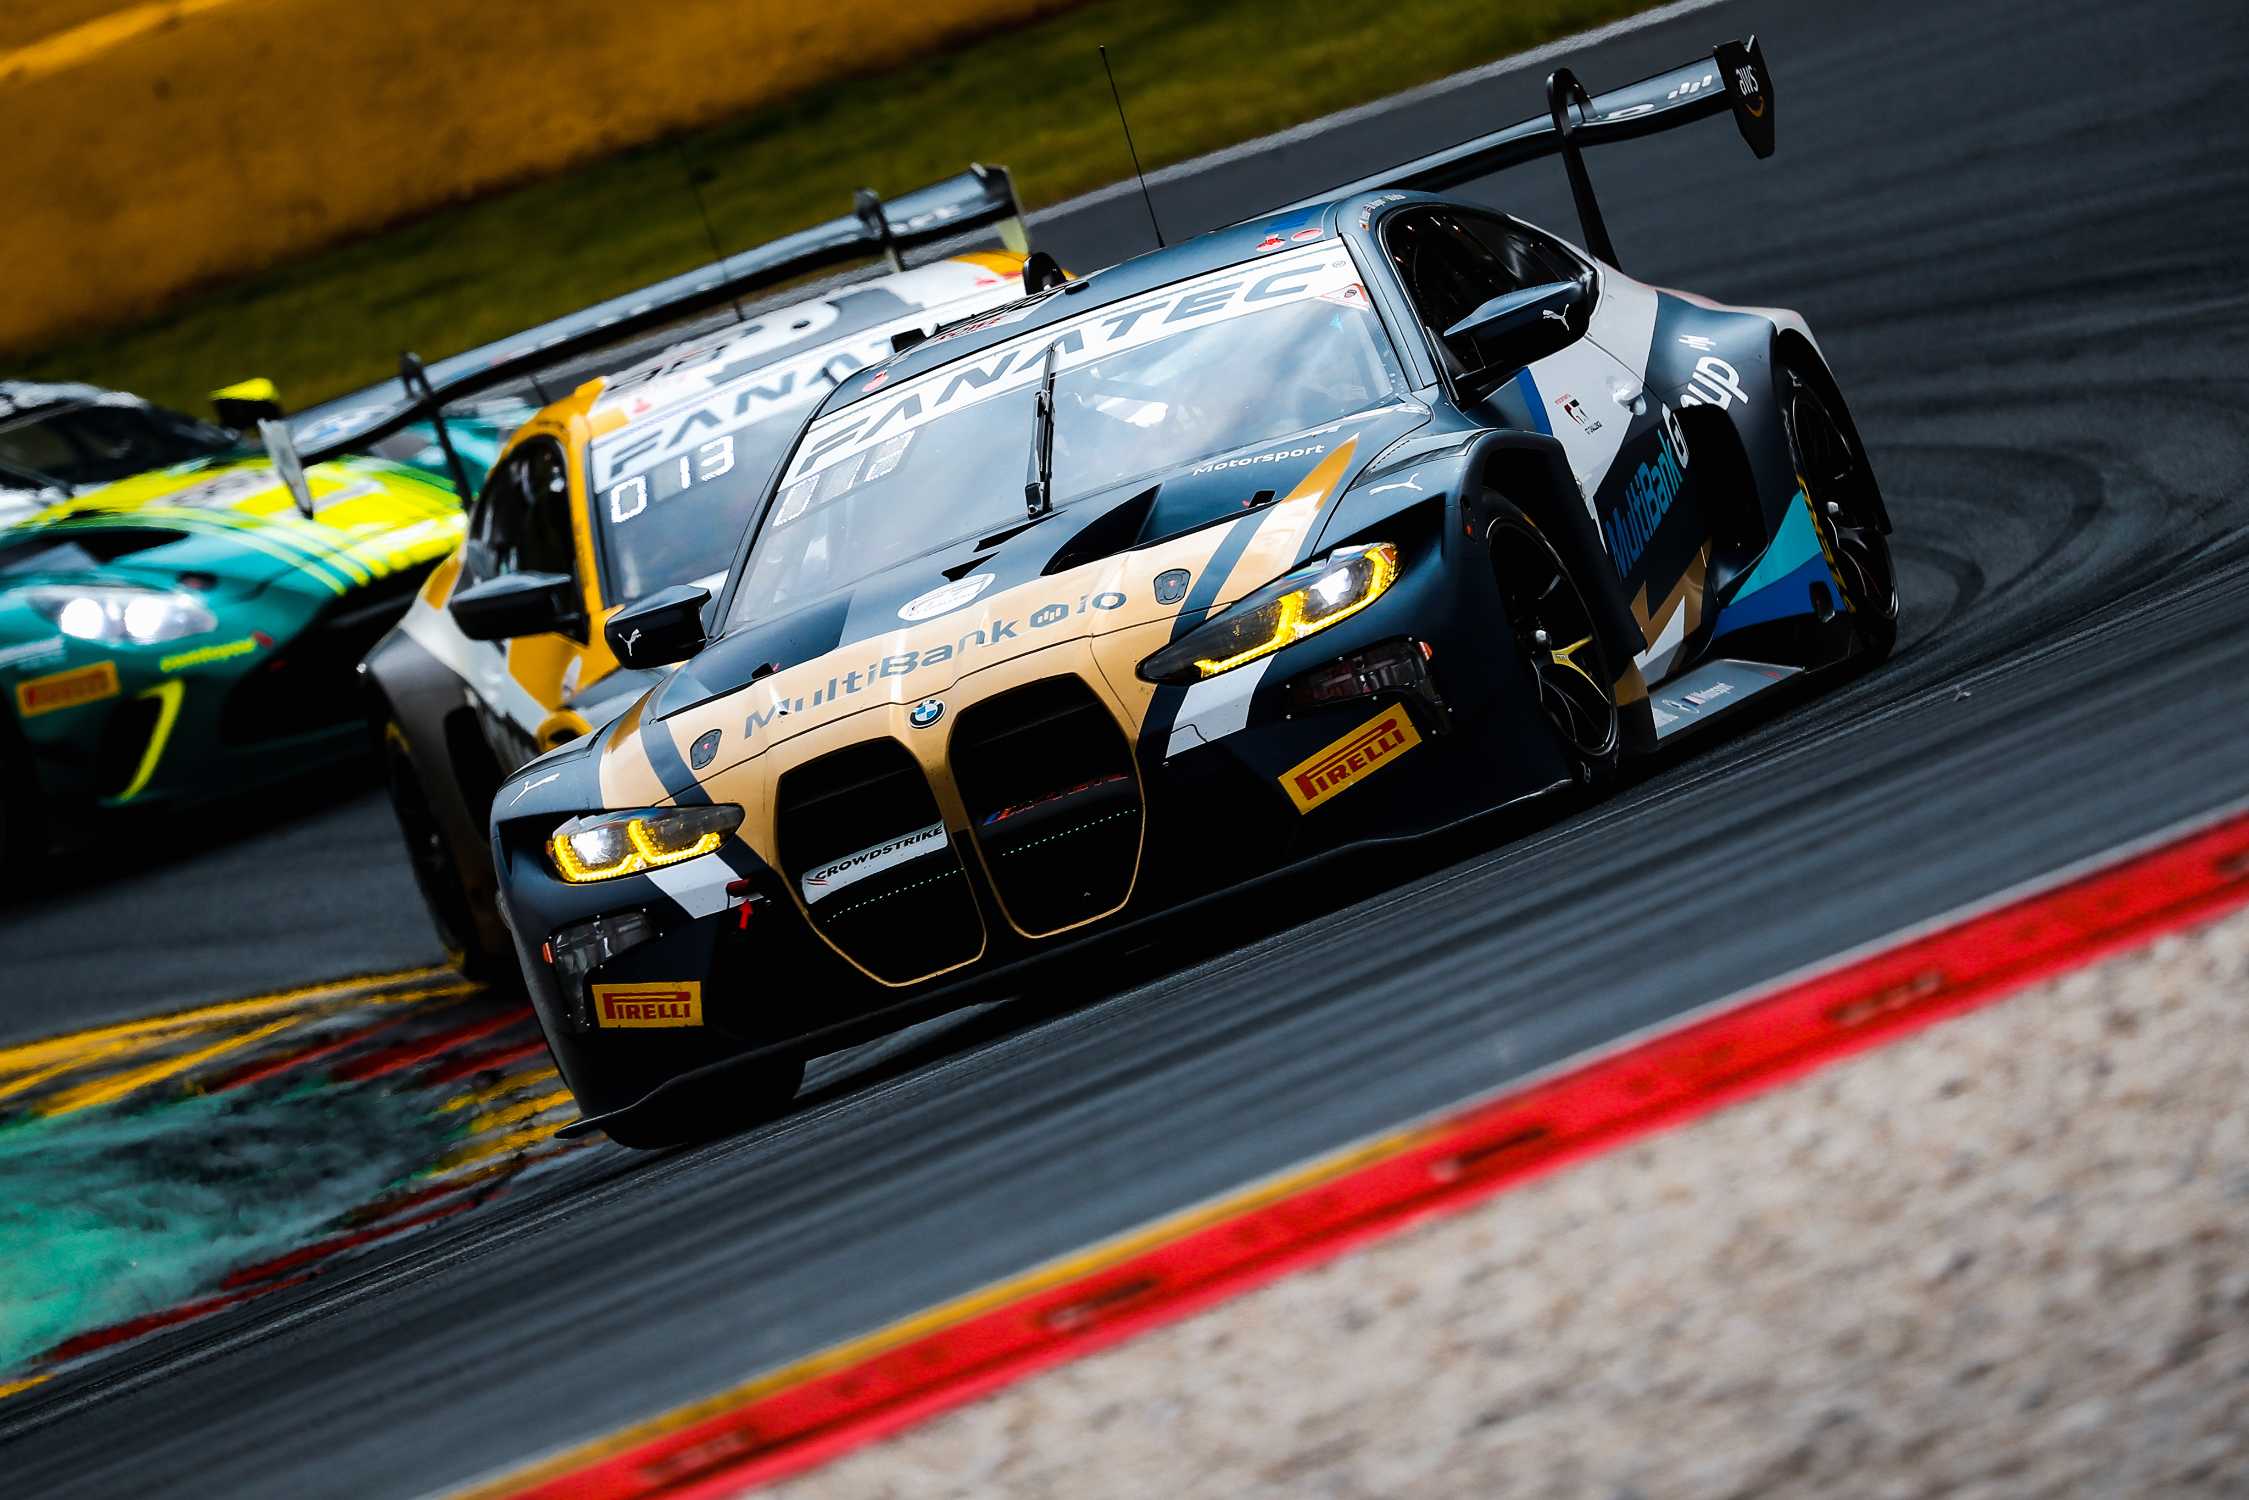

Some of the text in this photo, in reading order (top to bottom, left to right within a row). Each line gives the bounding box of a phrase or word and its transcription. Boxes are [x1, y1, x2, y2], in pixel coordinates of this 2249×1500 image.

[1735, 64, 1759, 96] aws
[795, 262, 1327, 479] FANATEC
[1191, 443, 1326, 477] Motorsport
[743, 616, 1021, 740] MultiBank
[1293, 718, 1406, 801] PIRELLI
[814, 824, 944, 881] CROWDSTRIKE
[602, 991, 692, 1020] PIRELLI
